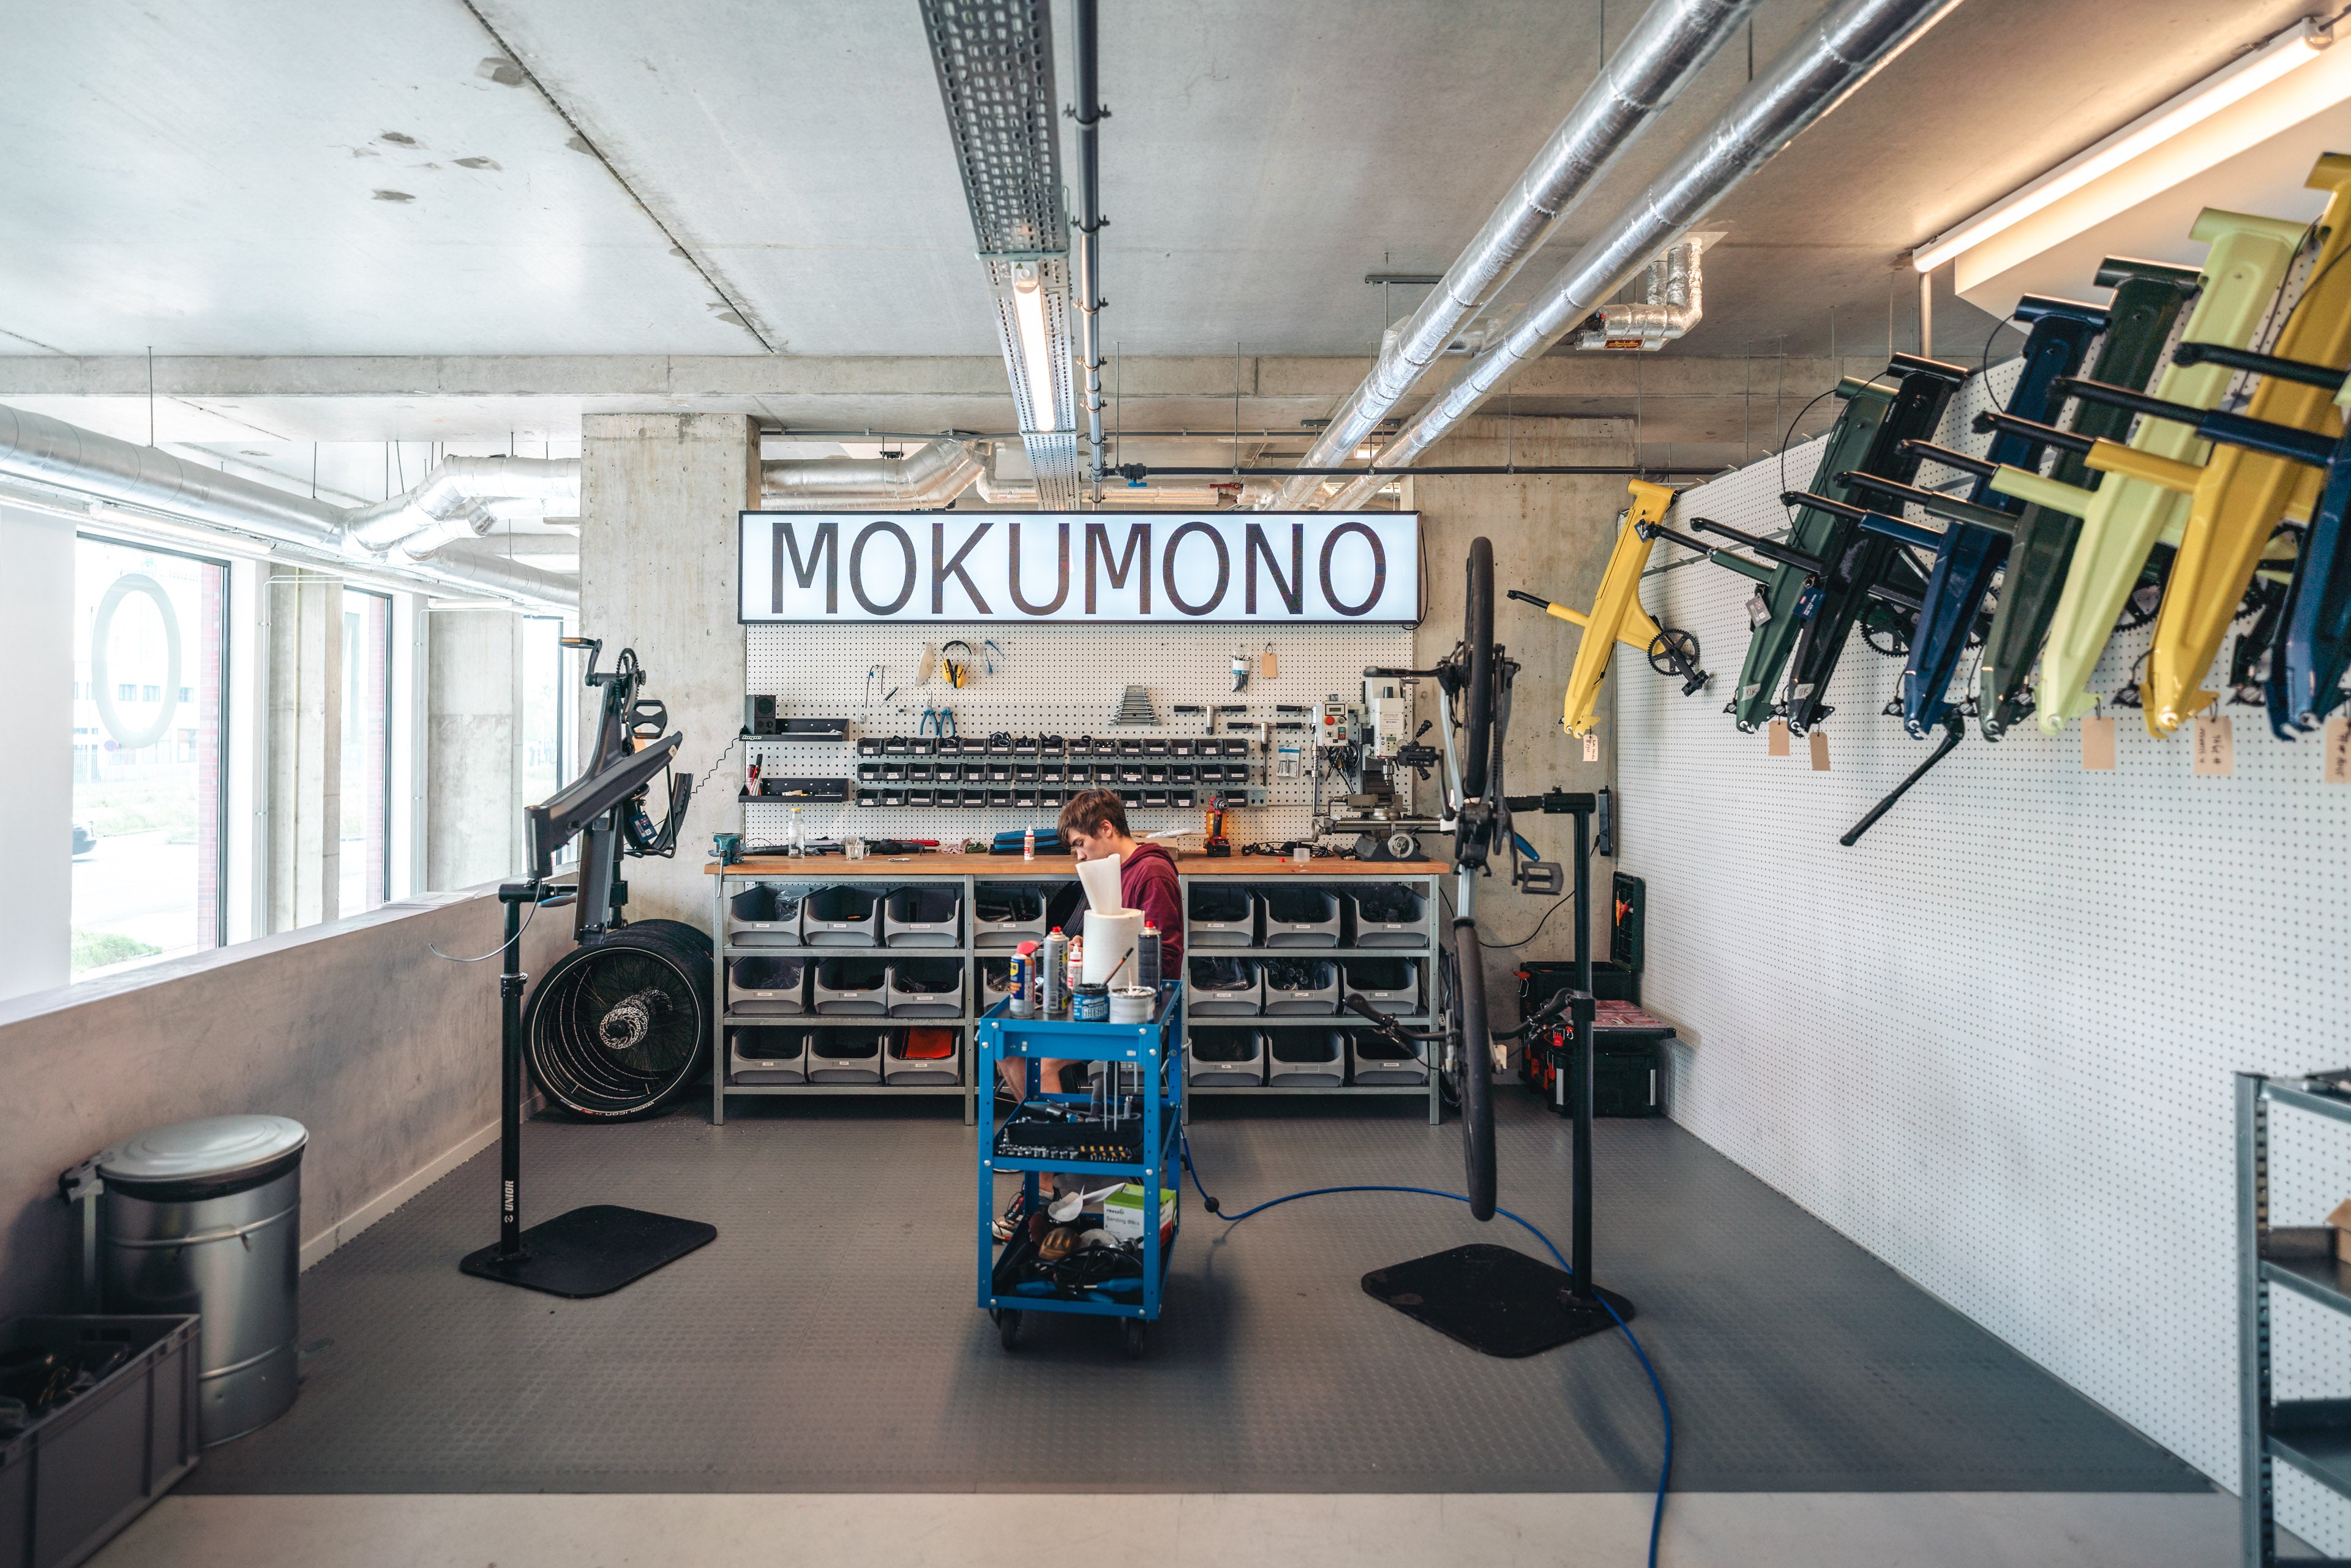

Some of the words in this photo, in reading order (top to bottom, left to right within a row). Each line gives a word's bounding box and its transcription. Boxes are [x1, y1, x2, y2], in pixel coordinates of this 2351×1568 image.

[771, 521, 1386, 616] MOKUMONO
[1746, 687, 1758, 696] OK
[1798, 686, 1809, 696] OK
[504, 1180, 514, 1211] UNIOR
[1106, 1216, 1127, 1225] Sanding
